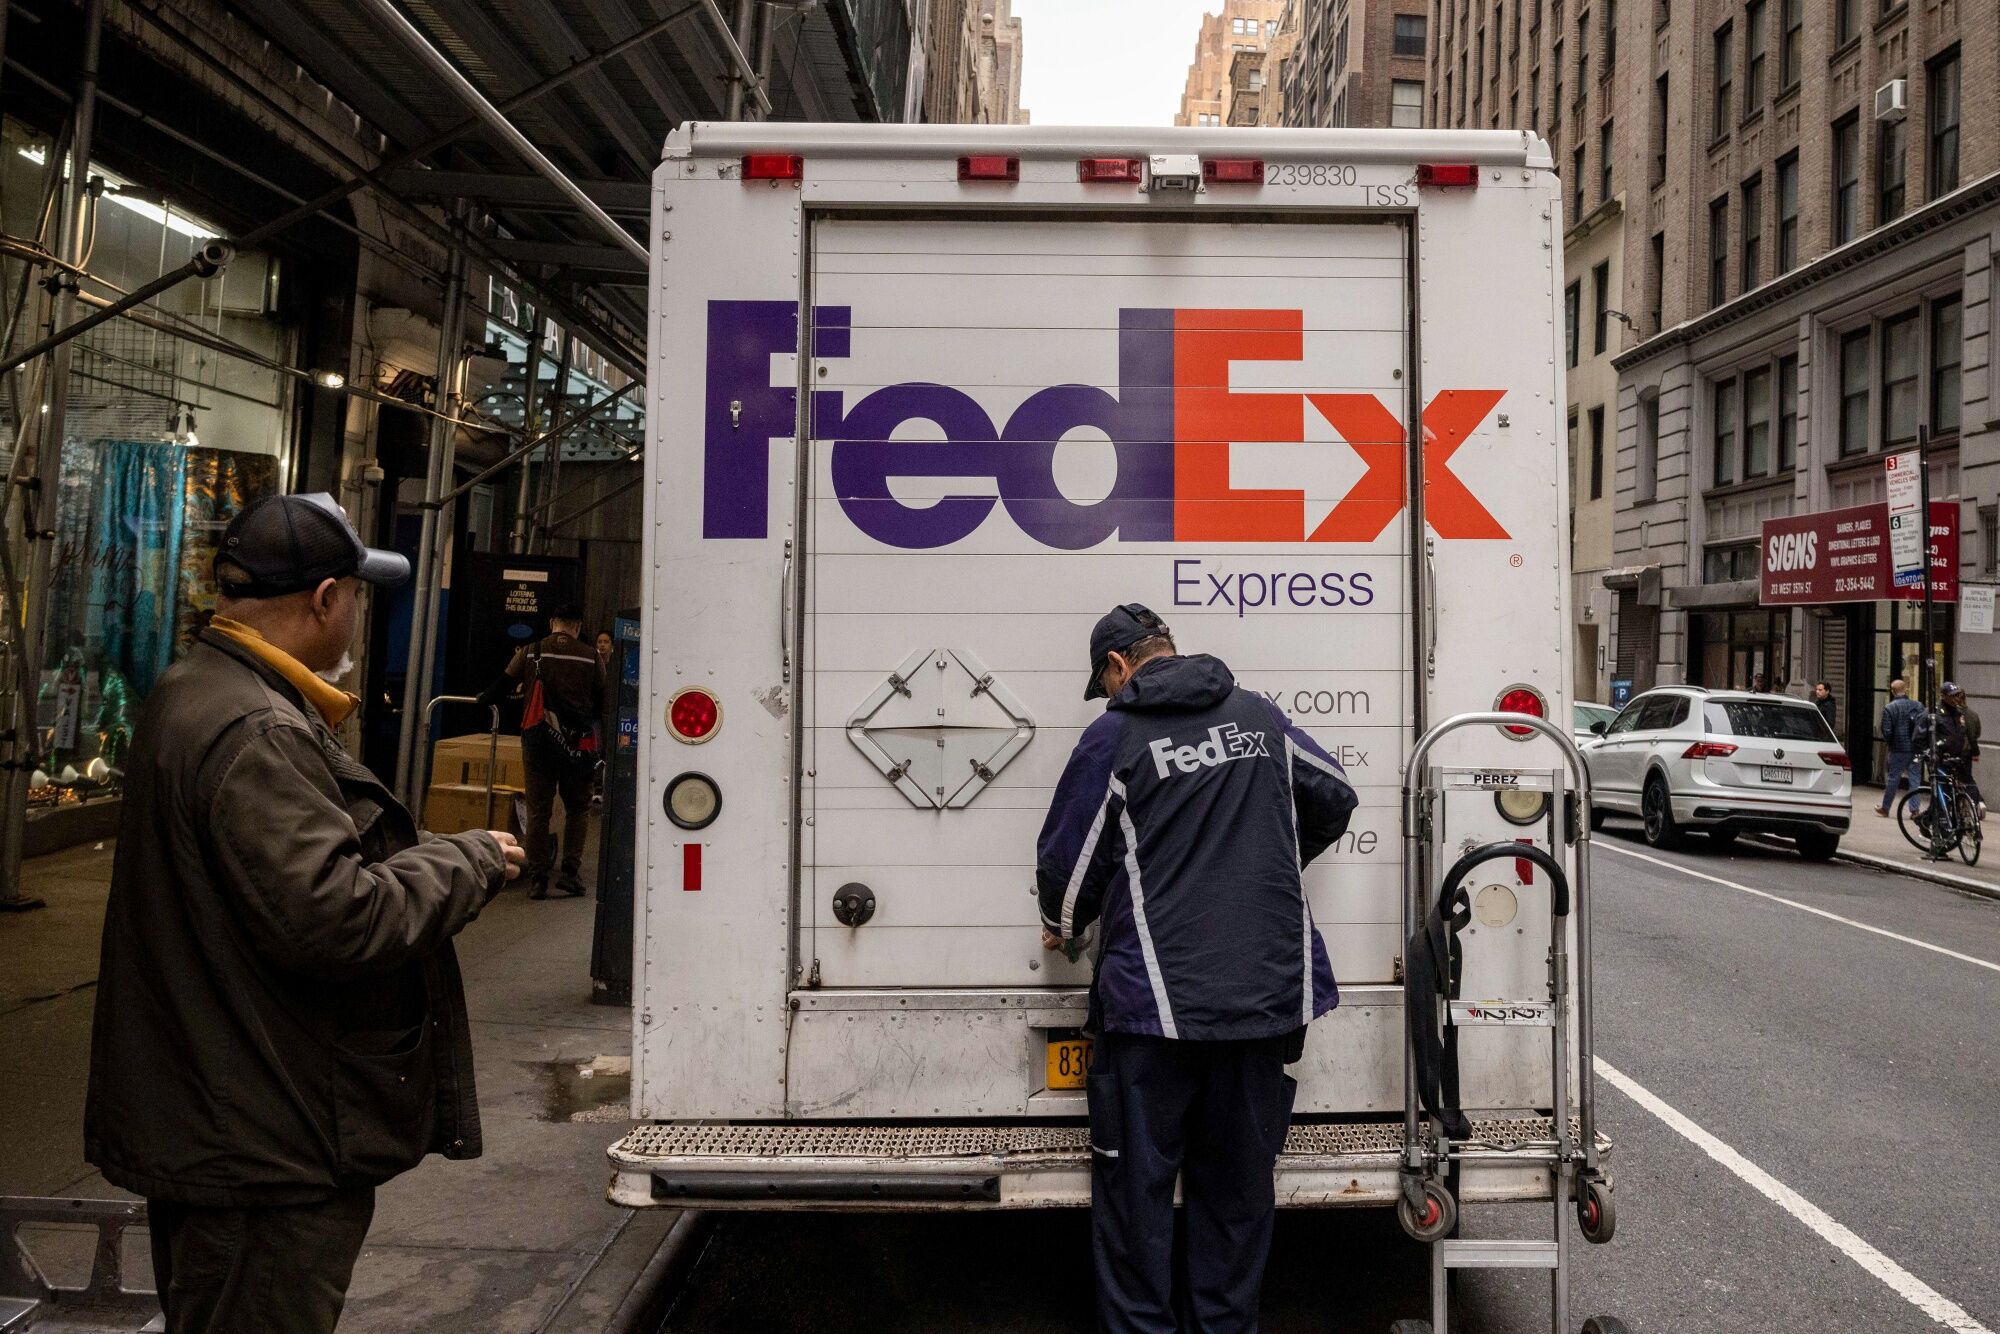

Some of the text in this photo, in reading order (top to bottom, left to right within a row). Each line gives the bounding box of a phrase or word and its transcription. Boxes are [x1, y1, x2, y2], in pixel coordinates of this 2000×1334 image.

[1267, 164, 1357, 186] 239830
[1359, 184, 1409, 207] TSS
[702, 299, 1513, 549] FedEx
[1889, 458, 1896, 470] 3
[1855, 519, 1872, 531] PLAQUES
[1892, 517, 1900, 529] 6
[1851, 537, 1867, 548] LETTERS
[1870, 535, 1881, 547] LOGO
[1767, 530, 1818, 572] SIGNS
[1830, 556, 1840, 567] VINYL
[1840, 555, 1857, 566] GRAPHICS
[1861, 553, 1878, 564] LETTERS
[1173, 559, 1374, 618] Express
[1770, 583, 1779, 595] 213
[1779, 583, 1791, 595] WEST
[1835, 575, 1875, 592] 212-354-5442
[510, 590, 535, 598] LOITERING
[512, 597, 529, 605] FRONT
[517, 604, 538, 613] BUILDING
[1619, 688, 1627, 699] P
[1264, 690, 1370, 714] x.com
[620, 721, 638, 733] 106
[1149, 722, 1271, 780] FedEx
[1328, 745, 1369, 767] dEx
[1473, 774, 1519, 785] PEREZ
